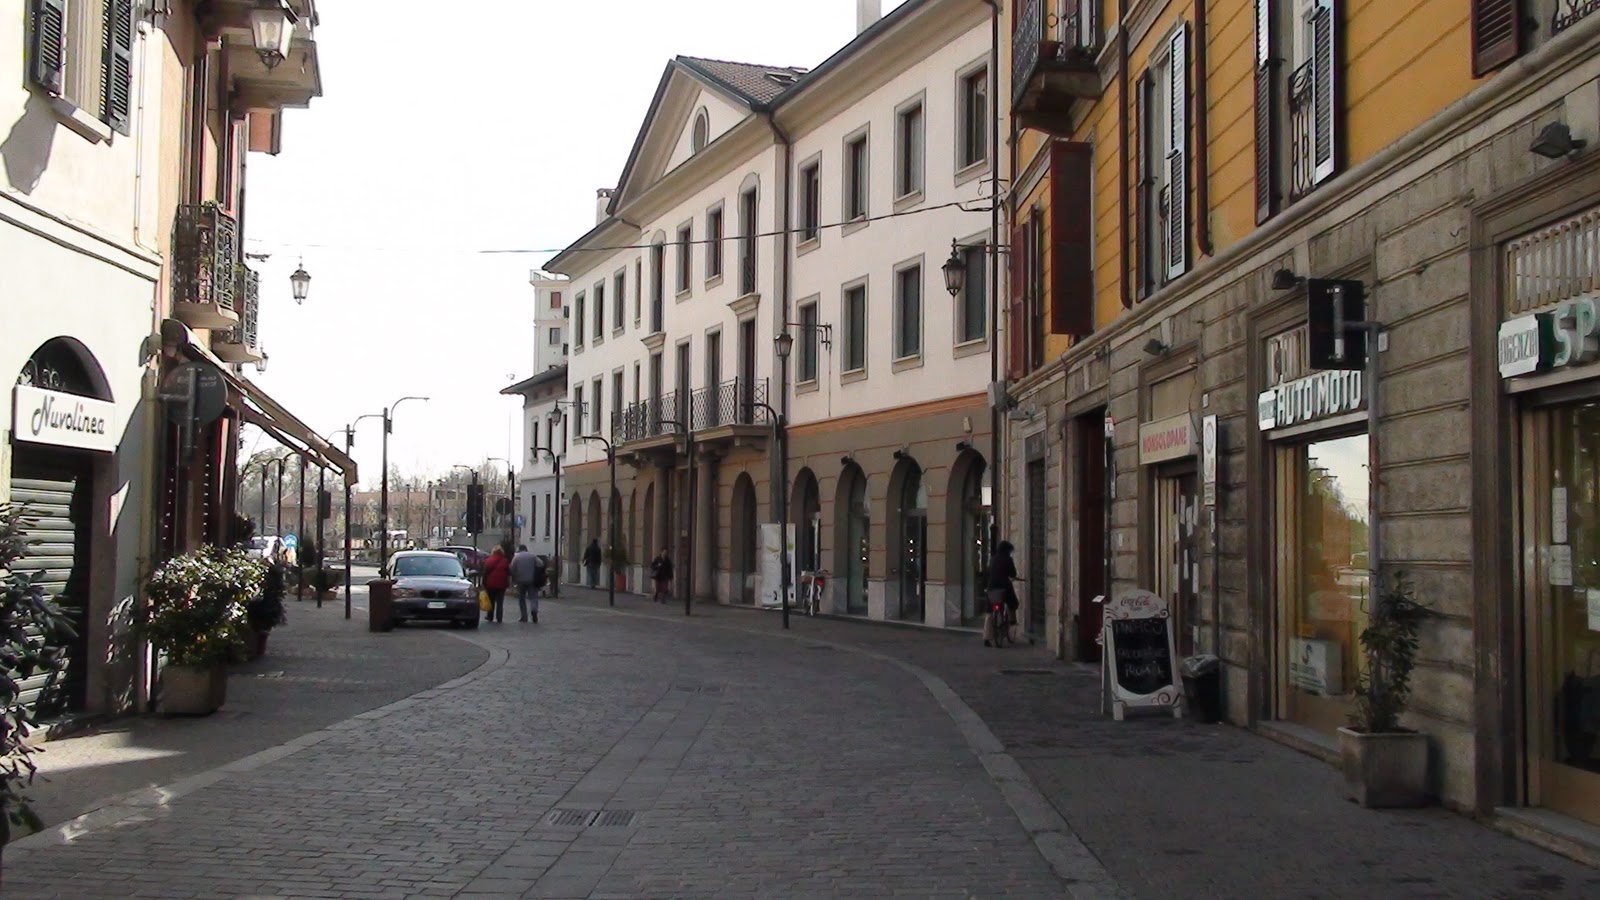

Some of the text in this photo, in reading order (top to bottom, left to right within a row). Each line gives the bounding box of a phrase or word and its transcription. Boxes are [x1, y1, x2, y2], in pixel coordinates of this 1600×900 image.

[31, 394, 105, 436] Nuvolinea
[1277, 379, 1313, 426] AUTO
[1317, 369, 1362, 417] MOTO
